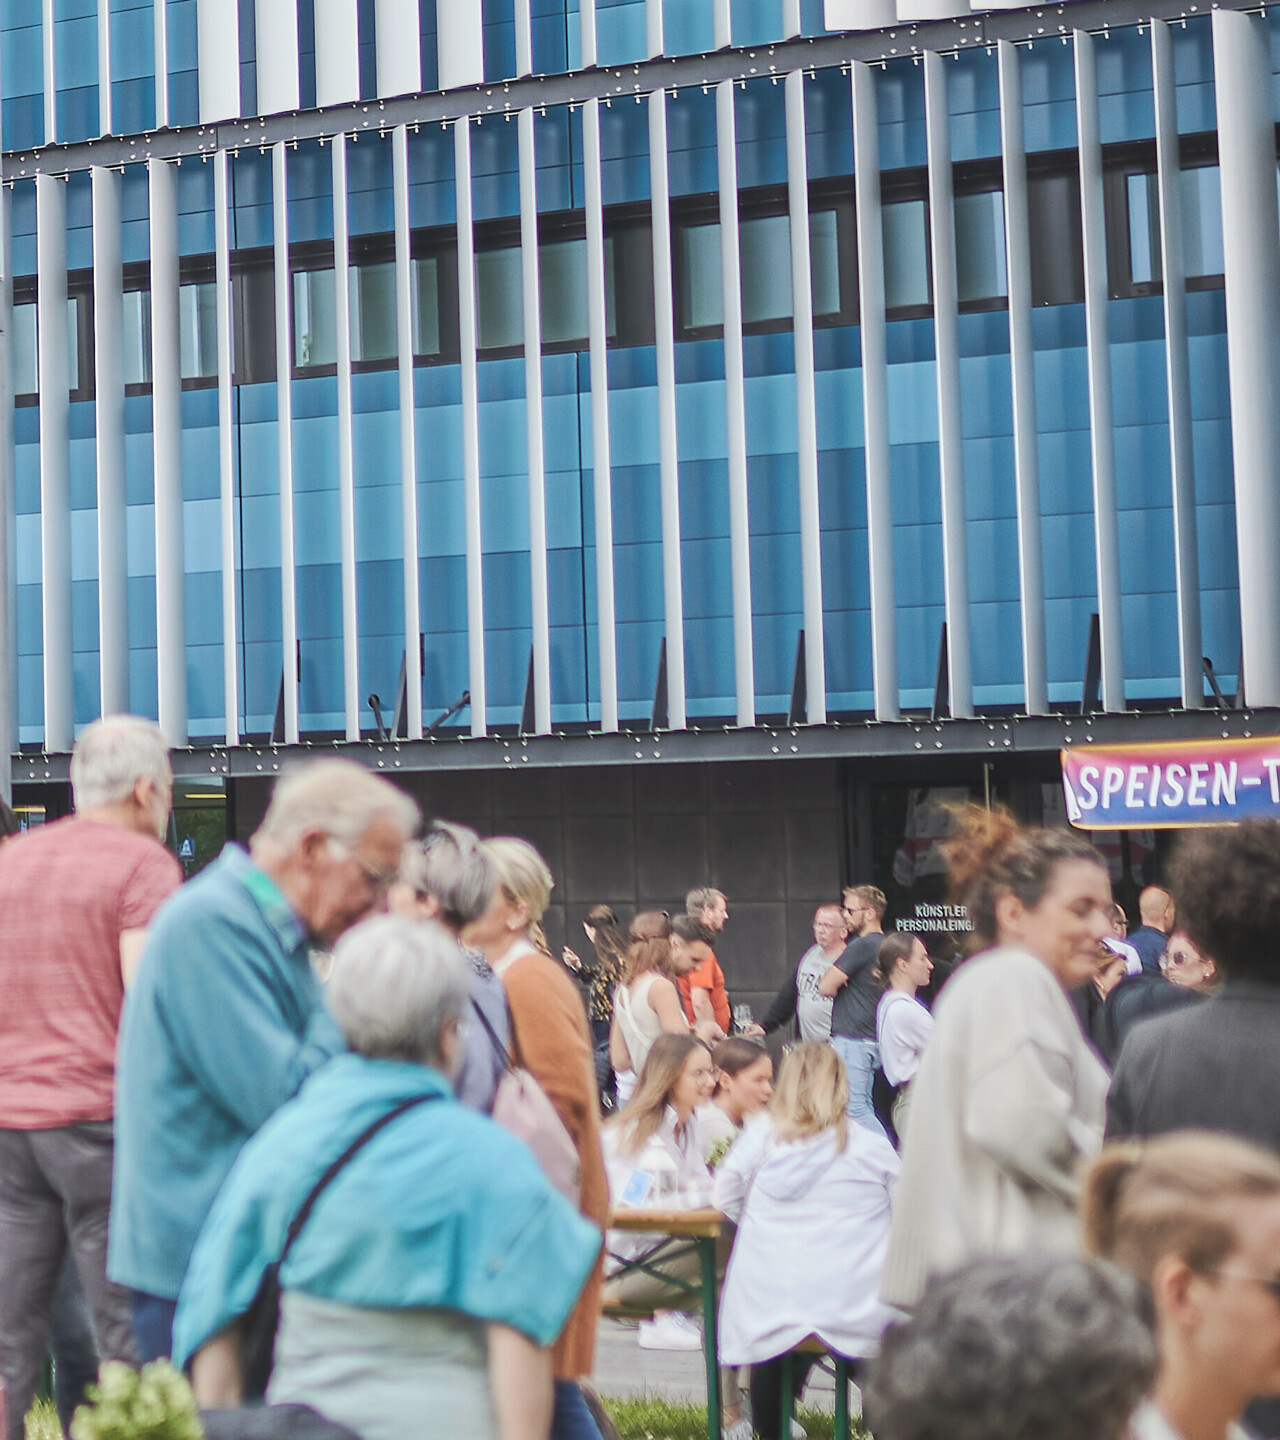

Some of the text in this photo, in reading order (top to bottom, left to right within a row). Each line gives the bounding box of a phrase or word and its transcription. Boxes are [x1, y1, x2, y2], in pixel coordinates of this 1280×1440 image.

[1077, 758, 1280, 810] SPEISEN-T
[915, 903, 968, 918] KÜNSTLER
[895, 918, 976, 932] PERSONALEING
